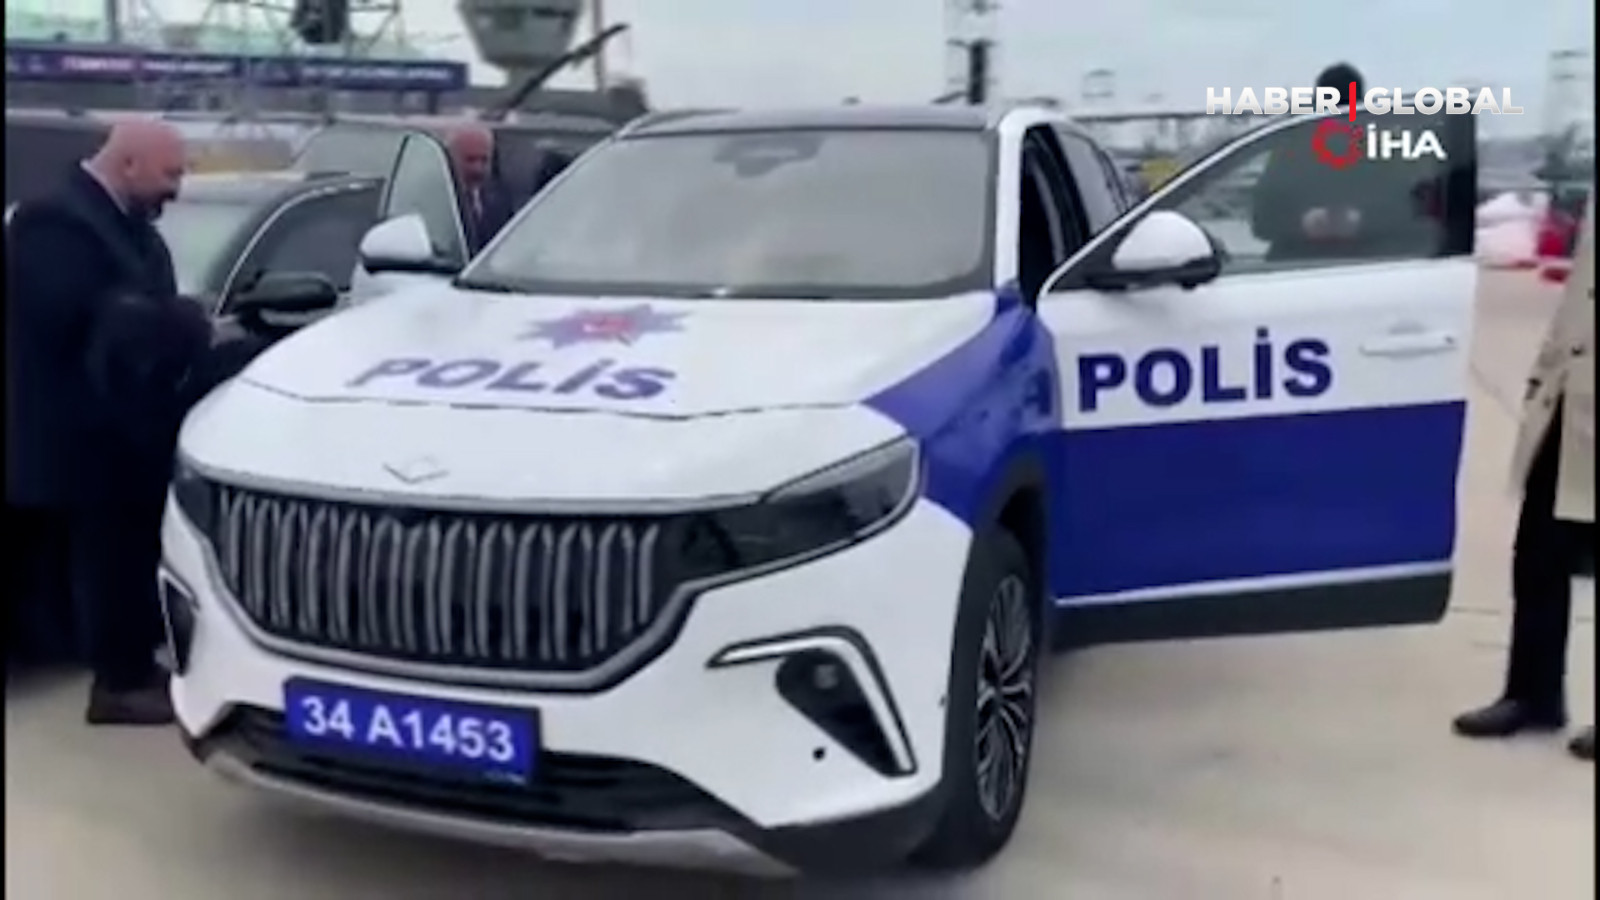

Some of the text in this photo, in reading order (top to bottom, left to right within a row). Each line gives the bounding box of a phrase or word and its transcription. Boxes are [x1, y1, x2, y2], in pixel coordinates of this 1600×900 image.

[346, 358, 678, 400] POLİS
[1077, 326, 1333, 413] POLİS
[302, 696, 515, 761] 34 A1453
